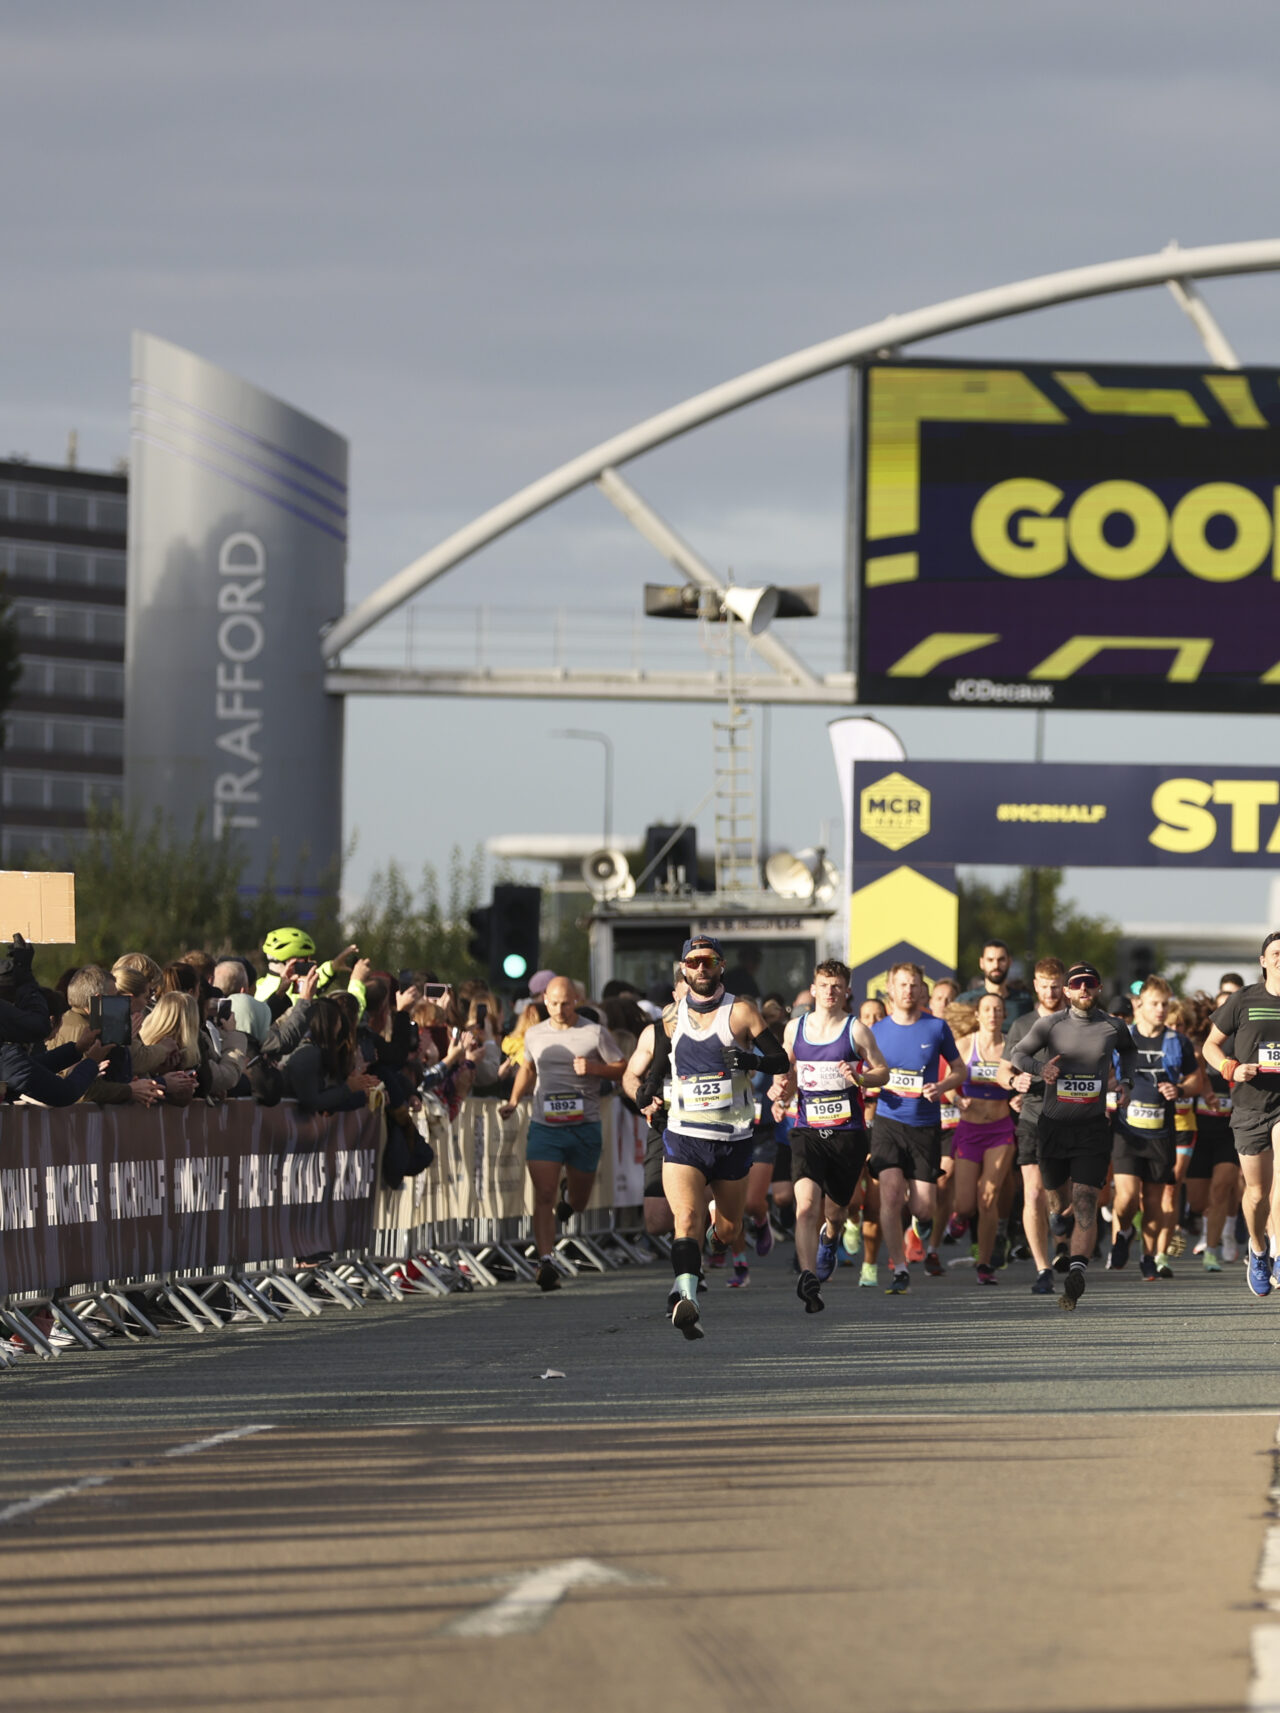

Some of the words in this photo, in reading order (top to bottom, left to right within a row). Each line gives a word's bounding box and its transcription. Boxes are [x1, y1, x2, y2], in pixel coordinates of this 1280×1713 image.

[213, 531, 267, 842] TRAFFORD
[949, 679, 1054, 702] JCDecaux
[867, 797, 922, 815] MCR
[996, 803, 1107, 823] #MCRHALF
[692, 1083, 721, 1096] 423
[1063, 1081, 1096, 1092] 2108
[549, 1101, 577, 1111] 1892
[813, 1102, 843, 1115] 1969
[1132, 1108, 1161, 1119] 9796
